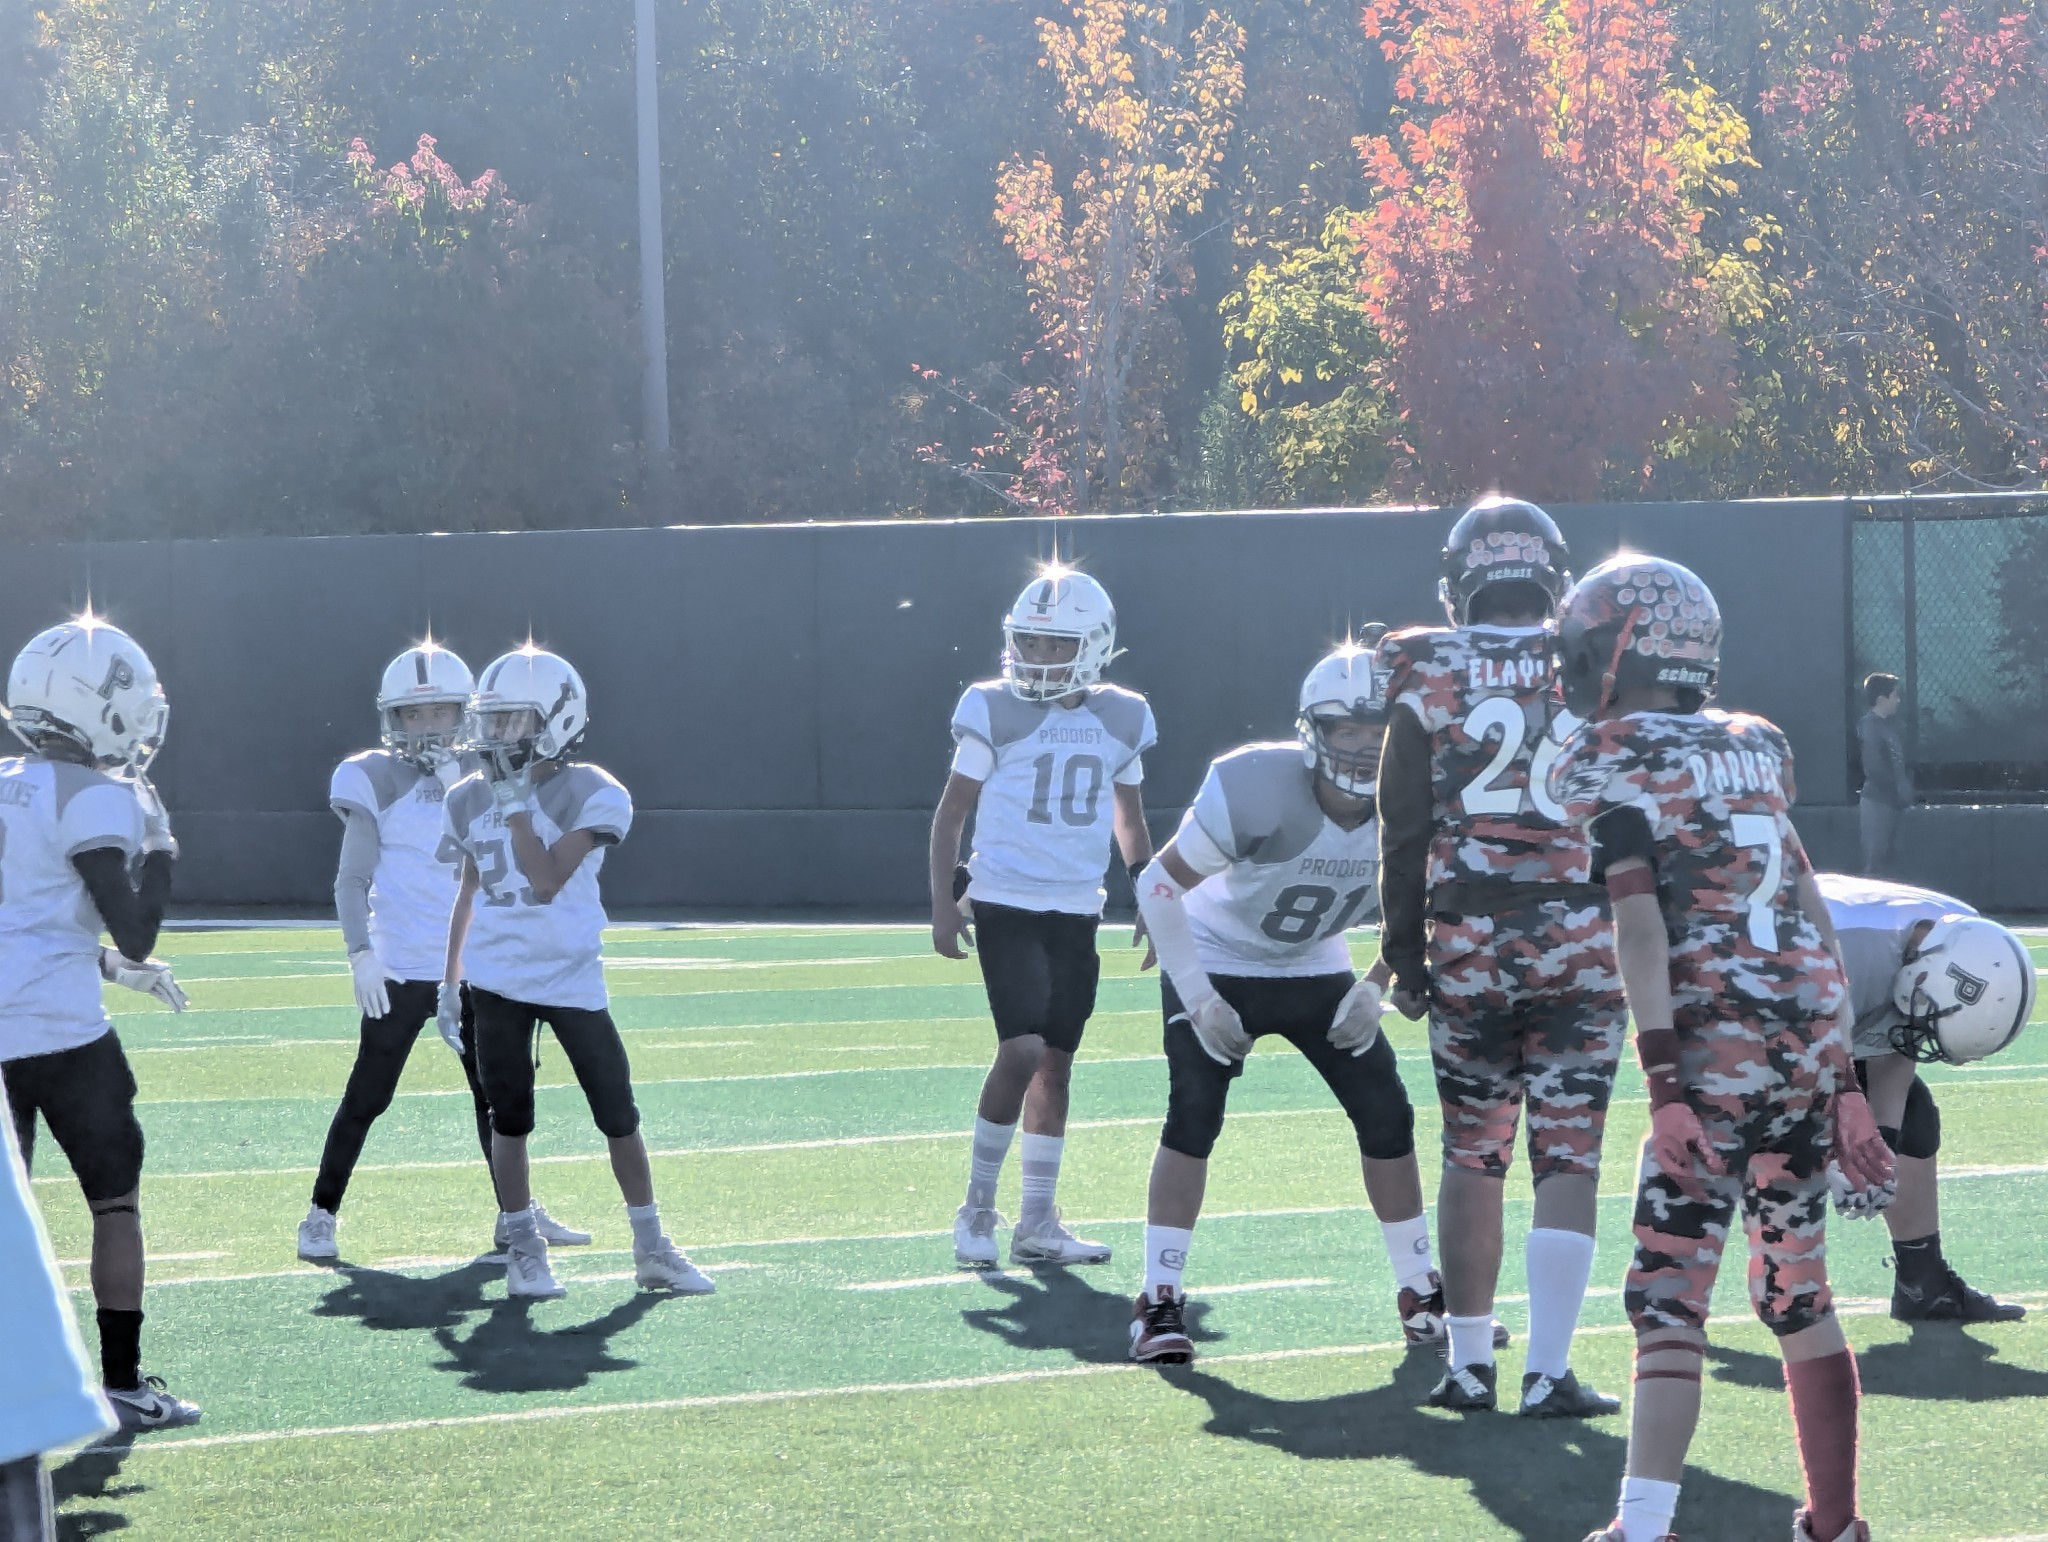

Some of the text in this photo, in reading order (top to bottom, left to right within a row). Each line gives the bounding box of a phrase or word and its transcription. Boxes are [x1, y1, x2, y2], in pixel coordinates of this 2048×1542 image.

[1468, 657, 1545, 688] ELAY
[1039, 728, 1103, 744] PRODIGY
[1026, 753, 1103, 826] 10
[473, 839, 553, 907] 2
[1730, 813, 1782, 953] 7
[1260, 884, 1371, 944] 81
